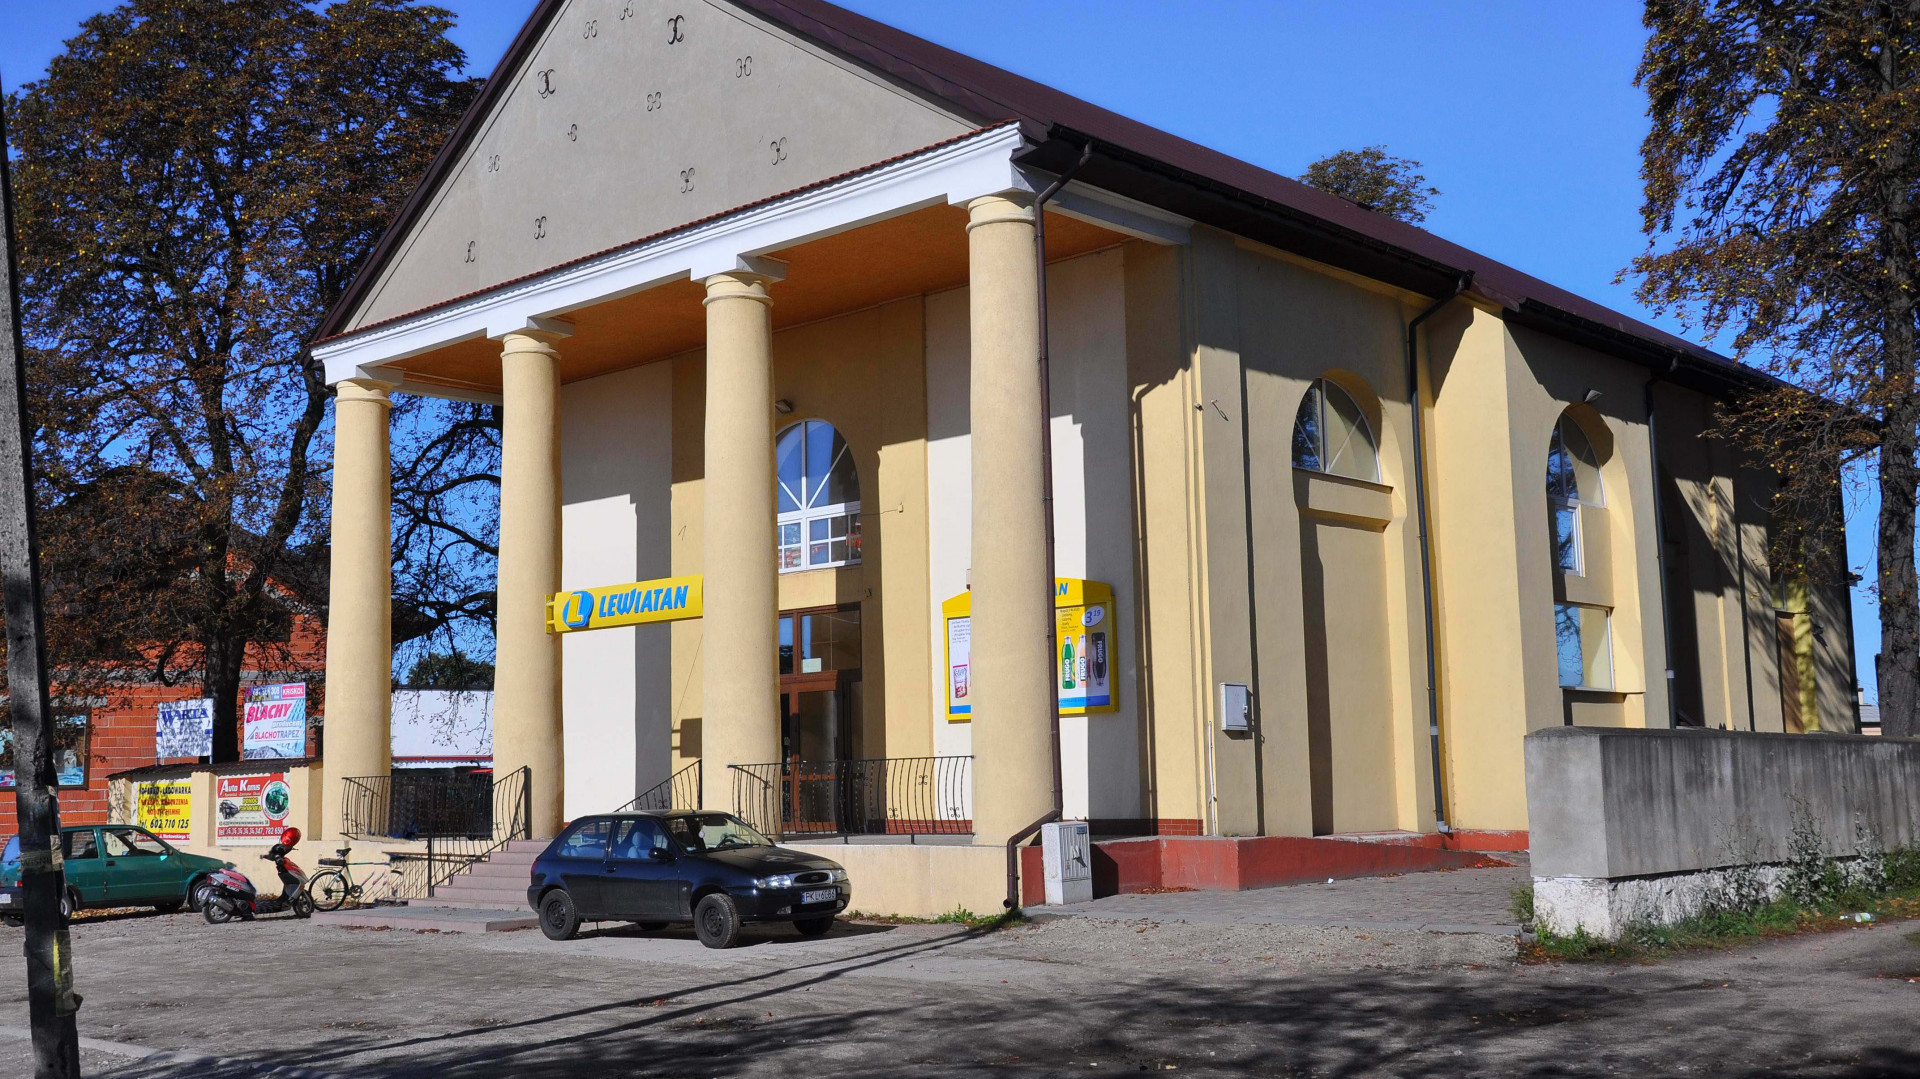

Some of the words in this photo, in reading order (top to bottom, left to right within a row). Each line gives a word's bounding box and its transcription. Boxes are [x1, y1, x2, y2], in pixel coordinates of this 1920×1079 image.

[598, 585, 689, 617] LEWIATAN
[282, 687, 304, 696] KRISKOL
[160, 708, 209, 726] WARTA
[246, 703, 292, 723] BLACHY
[254, 729, 300, 740] BLACHOTRAPEZ
[150, 818, 162, 829] 602
[164, 818, 175, 829] 710
[177, 818, 190, 829] 125
